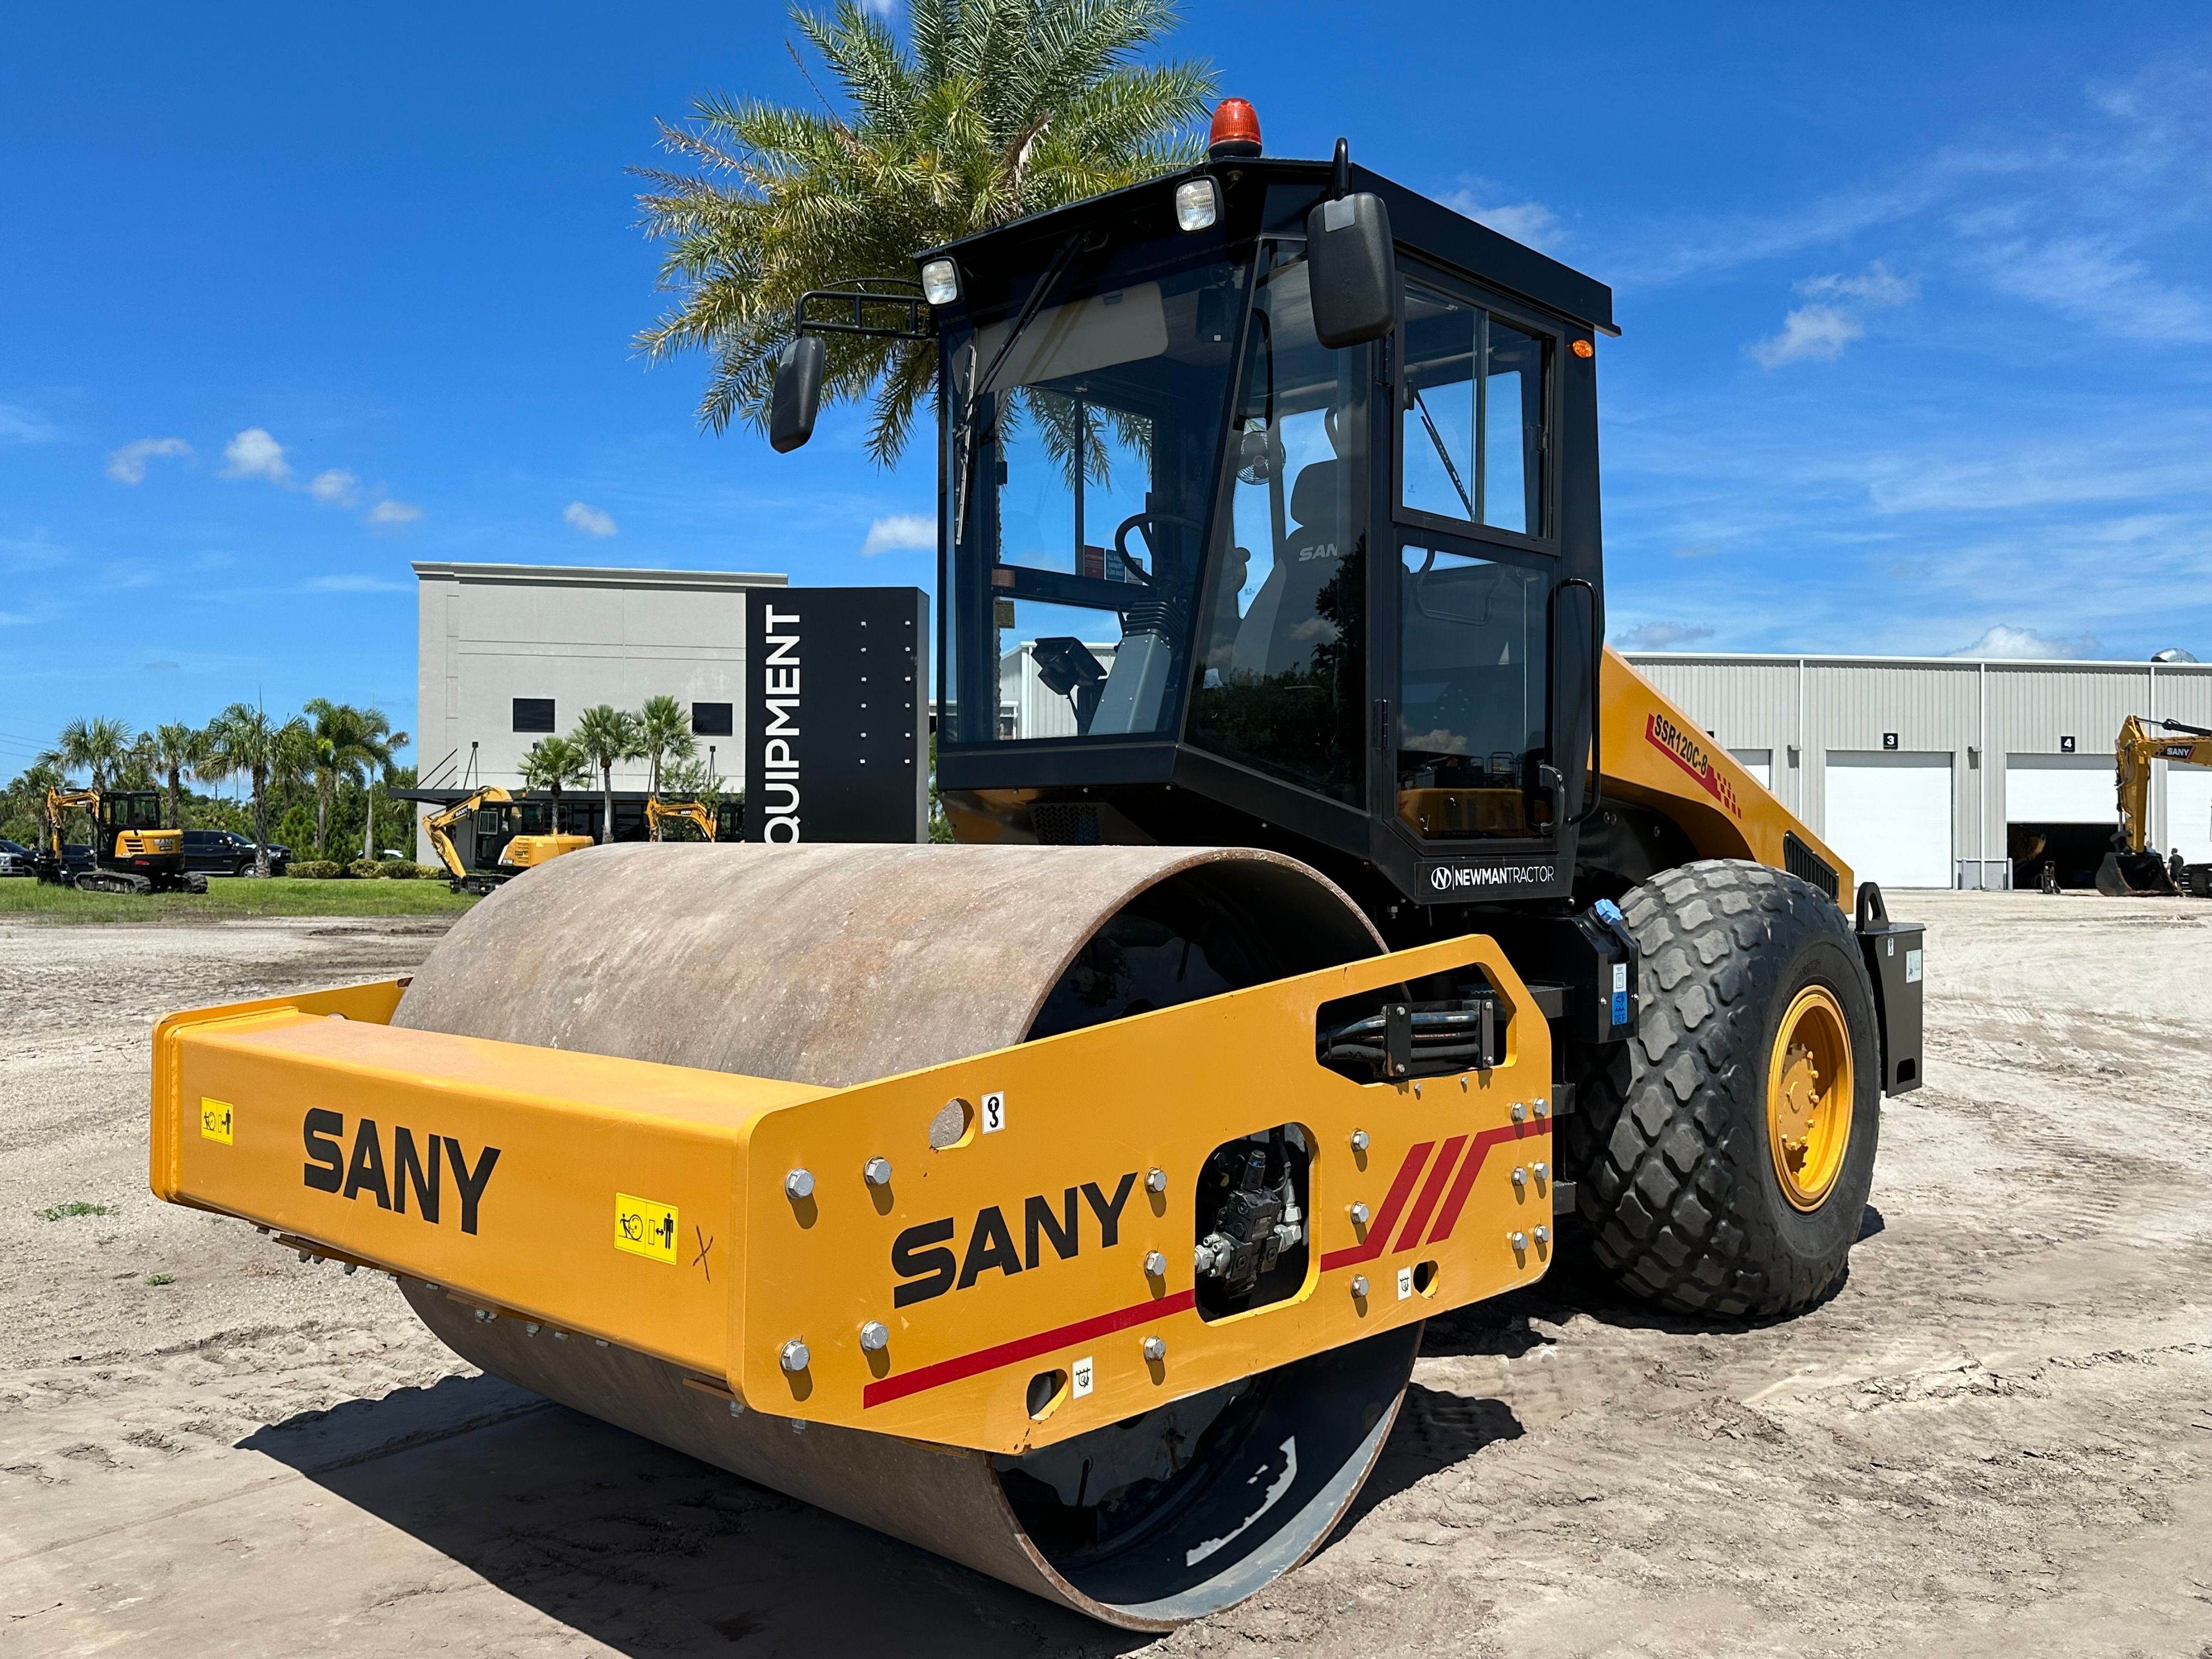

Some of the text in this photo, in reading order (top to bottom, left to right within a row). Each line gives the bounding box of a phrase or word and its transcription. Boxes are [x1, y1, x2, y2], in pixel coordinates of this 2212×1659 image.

[1655, 714, 1708, 776] SSR120C-8
[1887, 735, 1894, 745] 3
[2064, 738, 2072, 748] 4
[2166, 748, 2190, 756] SANY
[1455, 866, 1555, 887] NEWMANTRACTOR
[1614, 1013, 1626, 1024] DEF
[303, 1108, 501, 1235] SANY
[891, 1172, 1138, 1309] SANY
